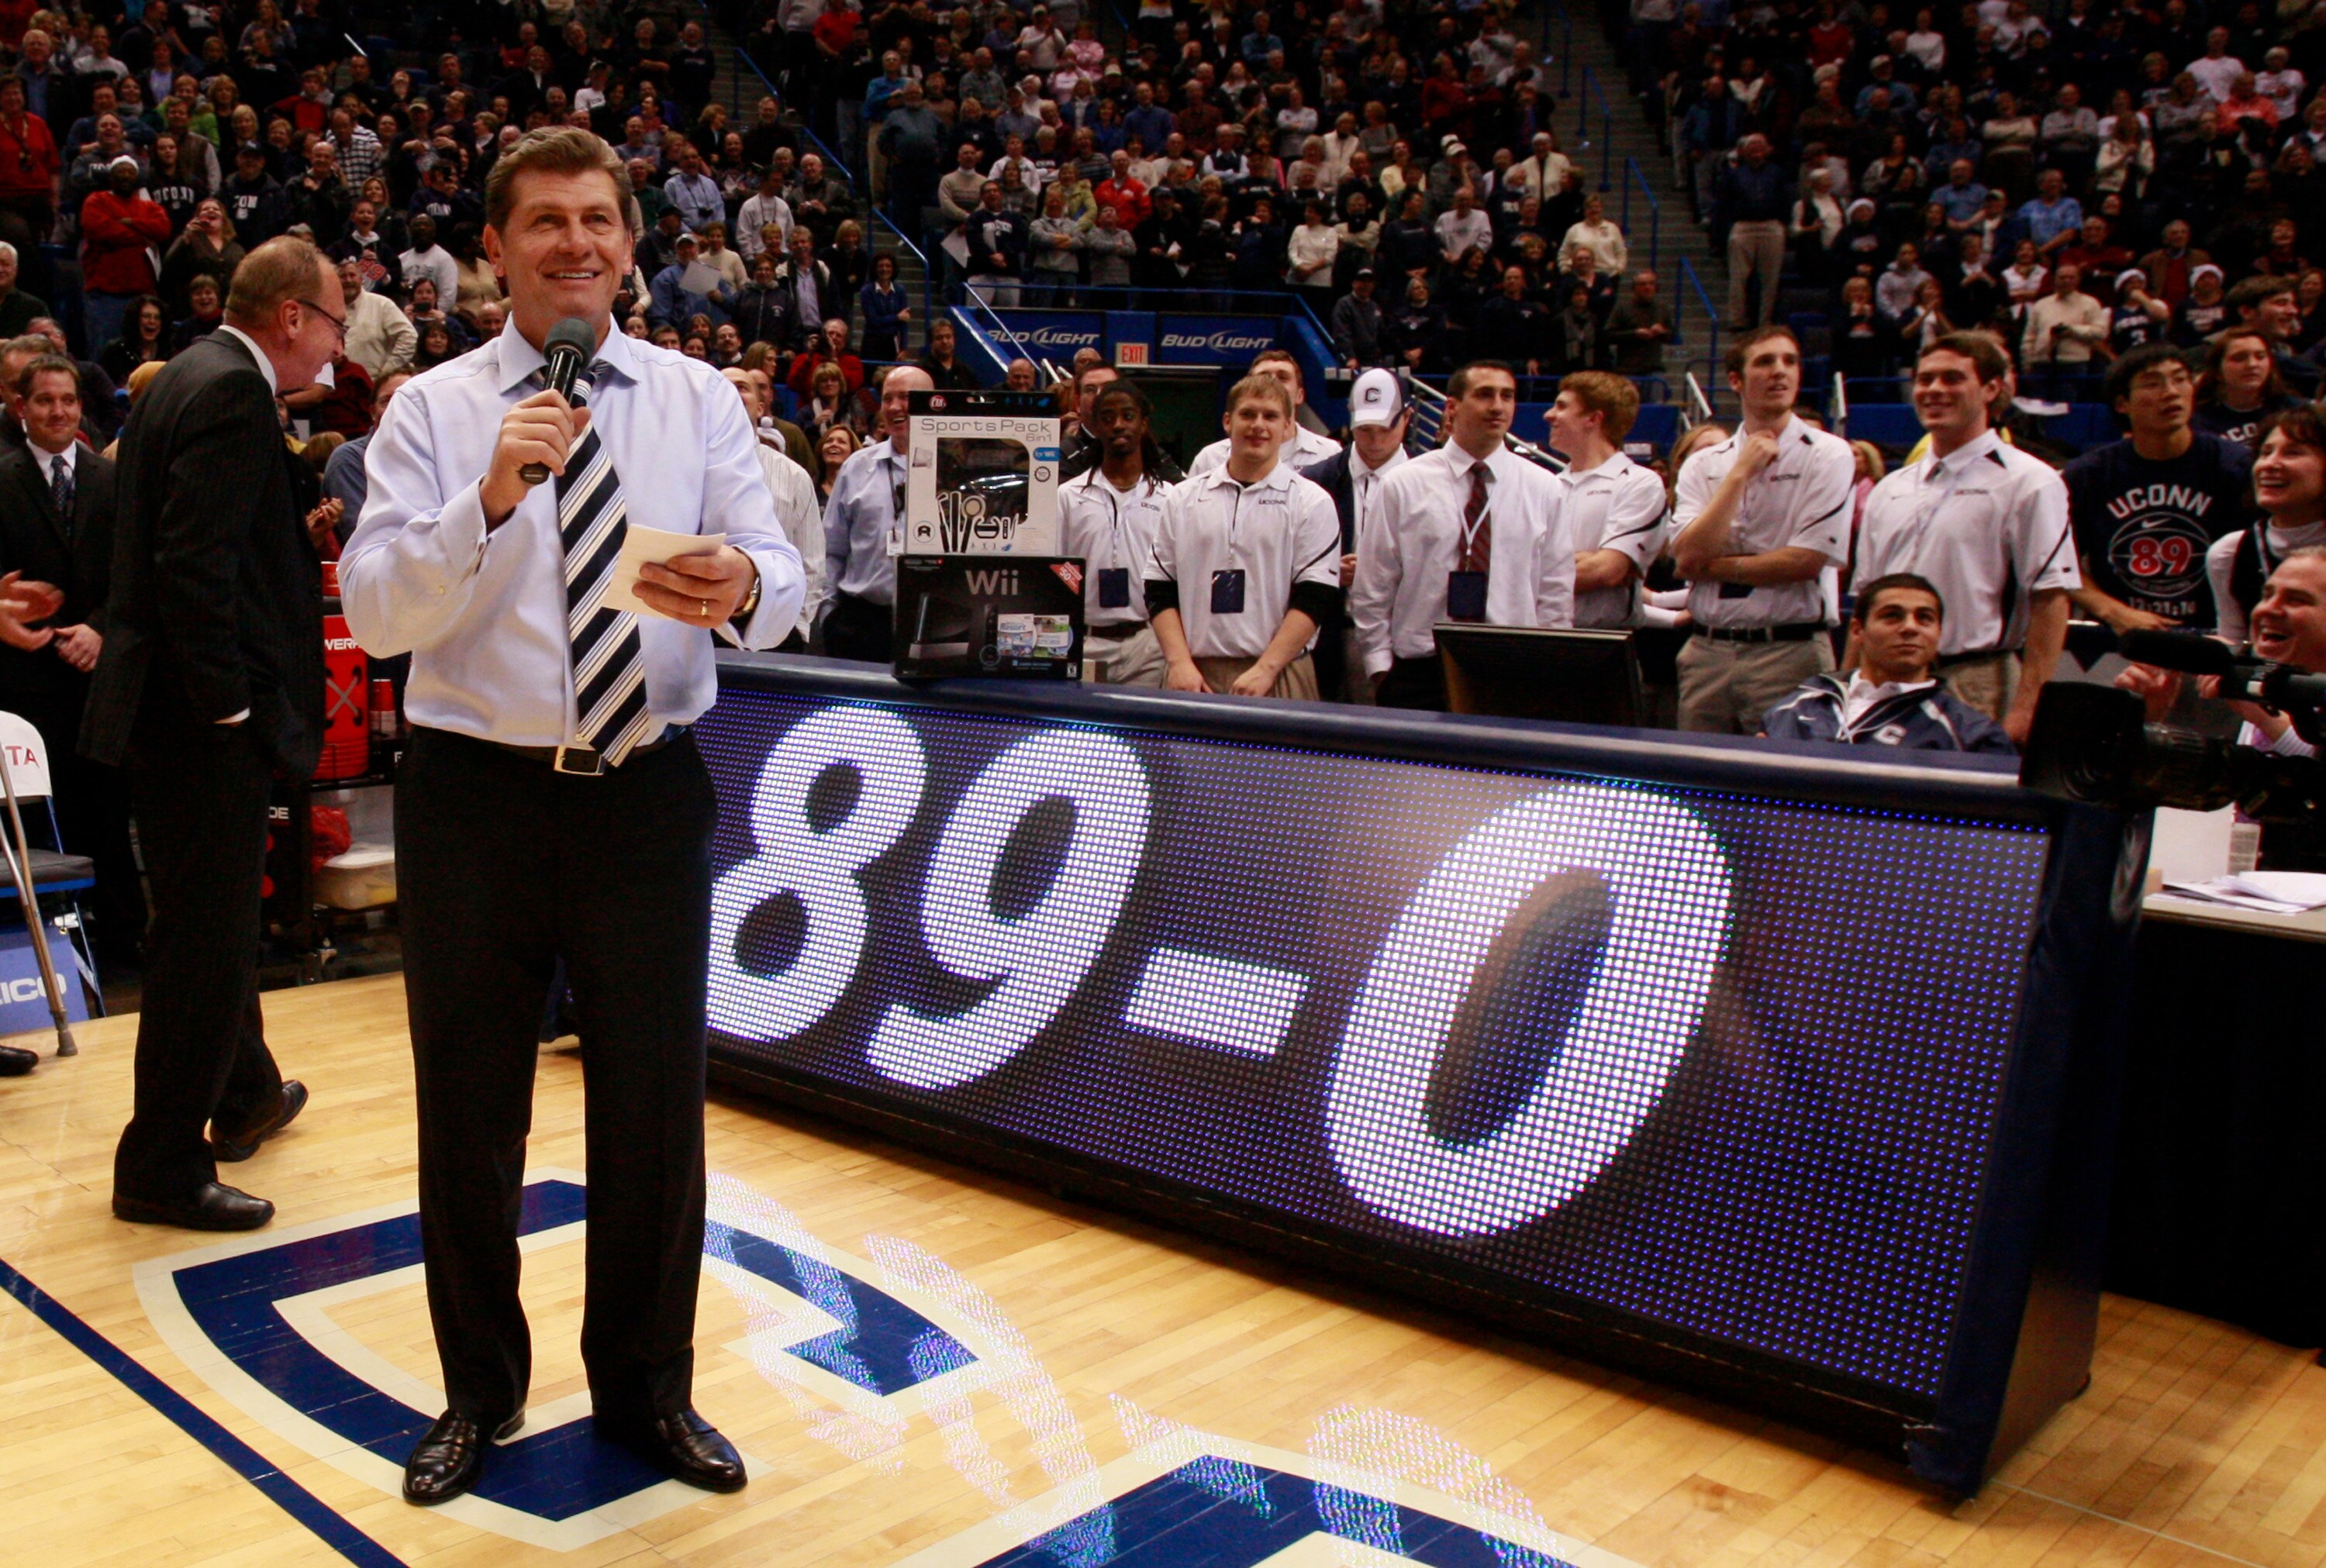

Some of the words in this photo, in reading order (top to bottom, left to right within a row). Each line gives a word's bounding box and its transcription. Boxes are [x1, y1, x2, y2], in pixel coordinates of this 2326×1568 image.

[1040, 333, 1099, 344] LIGHT
[1161, 334, 1206, 347] BUD
[1214, 337, 1273, 348] LIGHT
[1121, 346, 1144, 364] EXIT
[1365, 388, 1379, 402] C
[921, 419, 996, 433] Sports
[1001, 419, 1051, 433] Pack
[2107, 484, 2213, 519] UCONN
[2129, 536, 2192, 576] 89
[965, 569, 1019, 595] Wii
[1873, 723, 1907, 746] C
[704, 704, 1734, 1238] 89-0
[0, 974, 67, 1006] ICO
